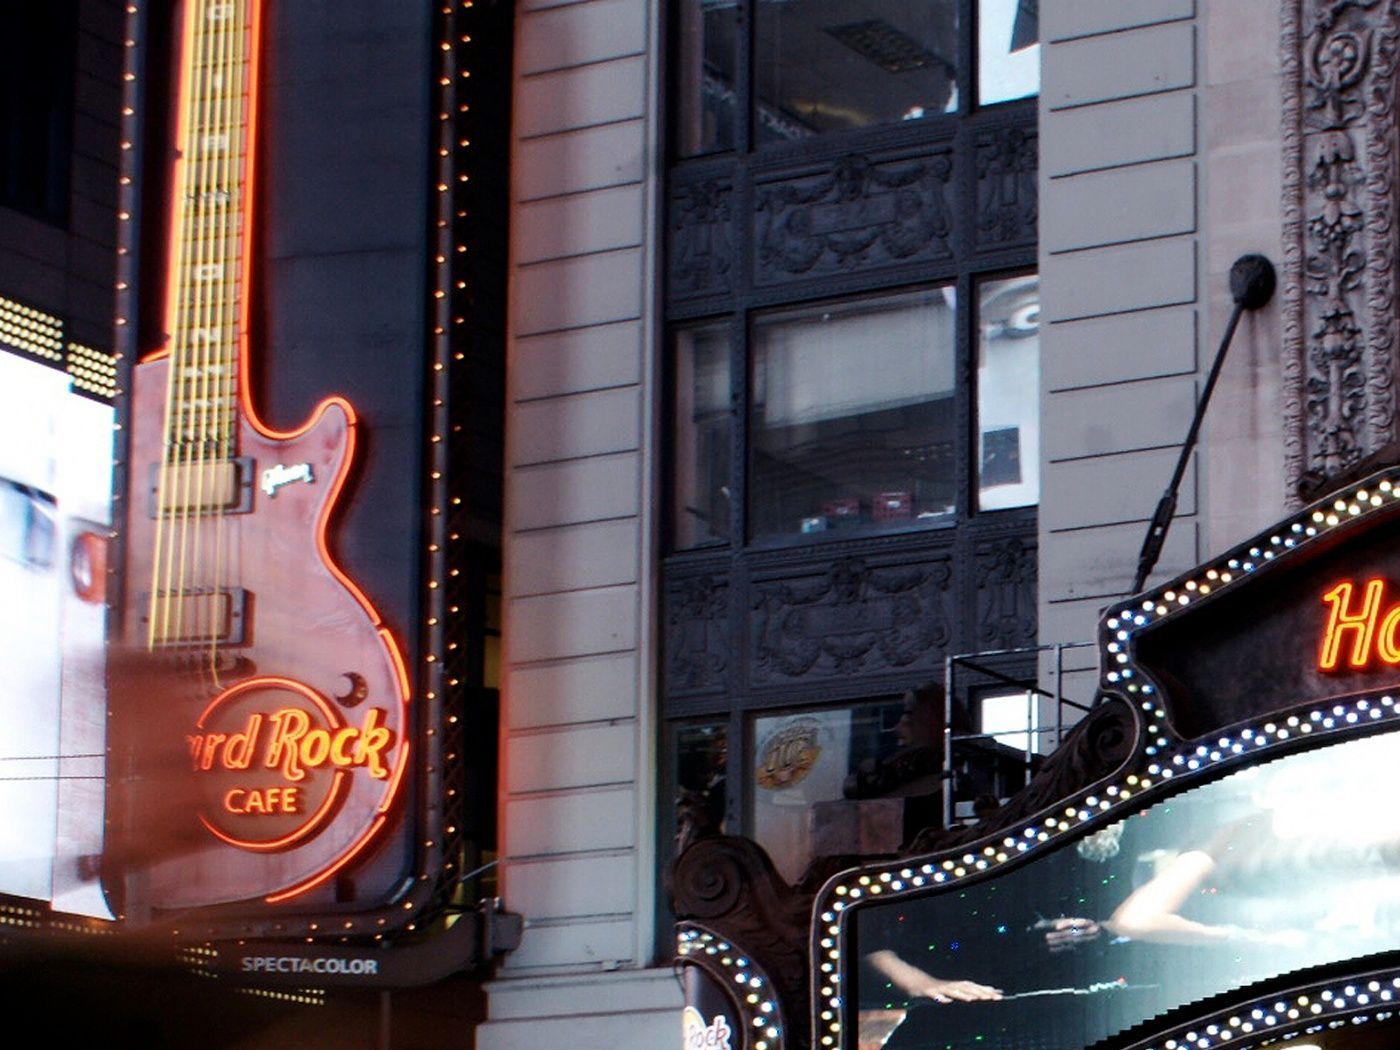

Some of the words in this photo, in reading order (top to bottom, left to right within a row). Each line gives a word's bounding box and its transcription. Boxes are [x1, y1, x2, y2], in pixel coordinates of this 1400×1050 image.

[266, 706, 390, 781] Rock
[224, 787, 297, 814] CAFE
[241, 956, 378, 975] SPECTACOLOR
